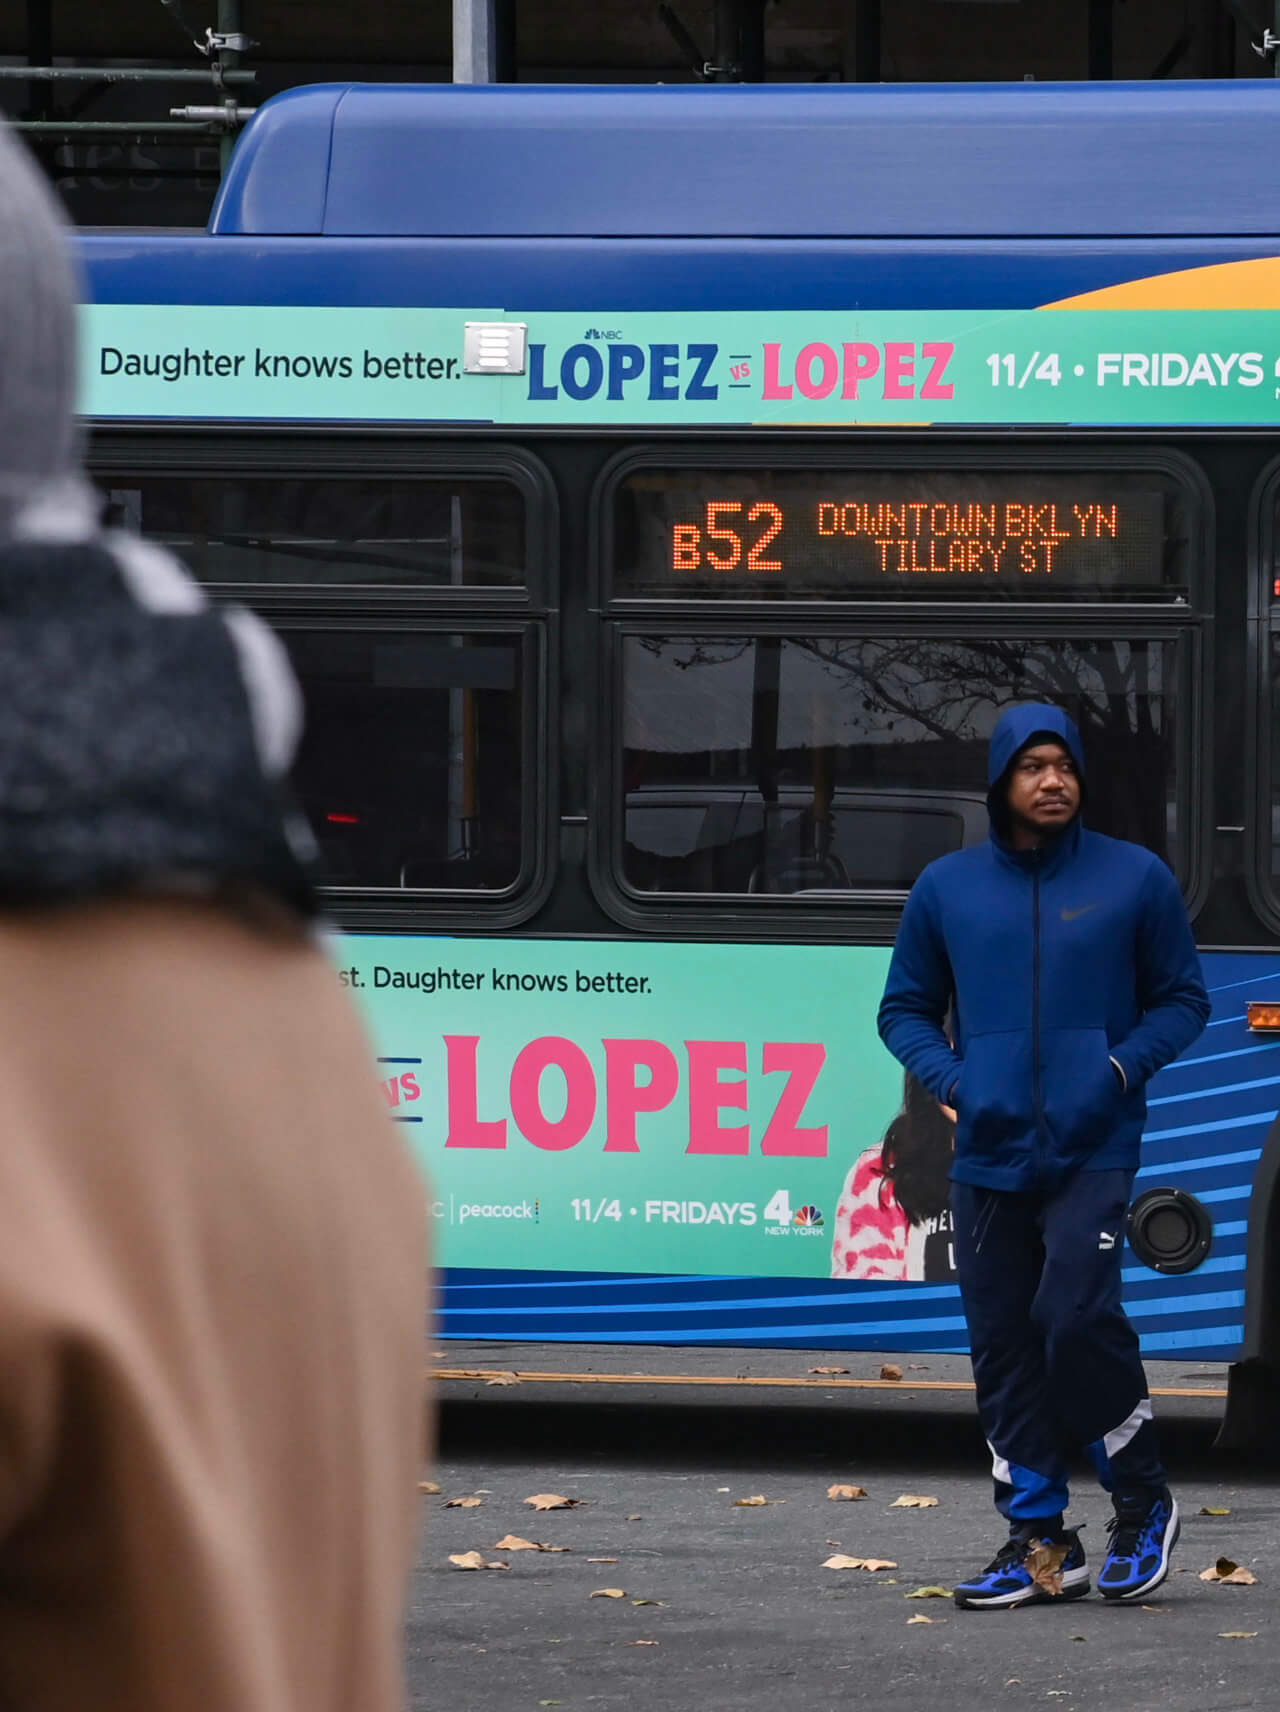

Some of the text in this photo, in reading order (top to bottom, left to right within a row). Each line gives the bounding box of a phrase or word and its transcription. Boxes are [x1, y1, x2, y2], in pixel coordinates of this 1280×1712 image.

[601, 330, 622, 339] NBC
[100, 347, 462, 382] Daughter knows better.
[527, 341, 955, 400] LOPEZ VS LOPEZ
[986, 352, 1264, 388] 11/4 FRIDAYS
[672, 501, 784, 571] B52
[817, 502, 1118, 538] DOWNTOWN BKLYN
[874, 539, 1060, 573] TILLARY ST
[373, 966, 485, 994] Daughter
[491, 967, 568, 992] knows
[575, 969, 652, 993] better.
[442, 1034, 828, 1157] LOPEZ
[459, 1200, 533, 1225] peacock
[571, 1198, 757, 1226] 11/4 FRIDAYS
[763, 1189, 795, 1226] 4
[764, 1226, 824, 1236] NEW YORK
